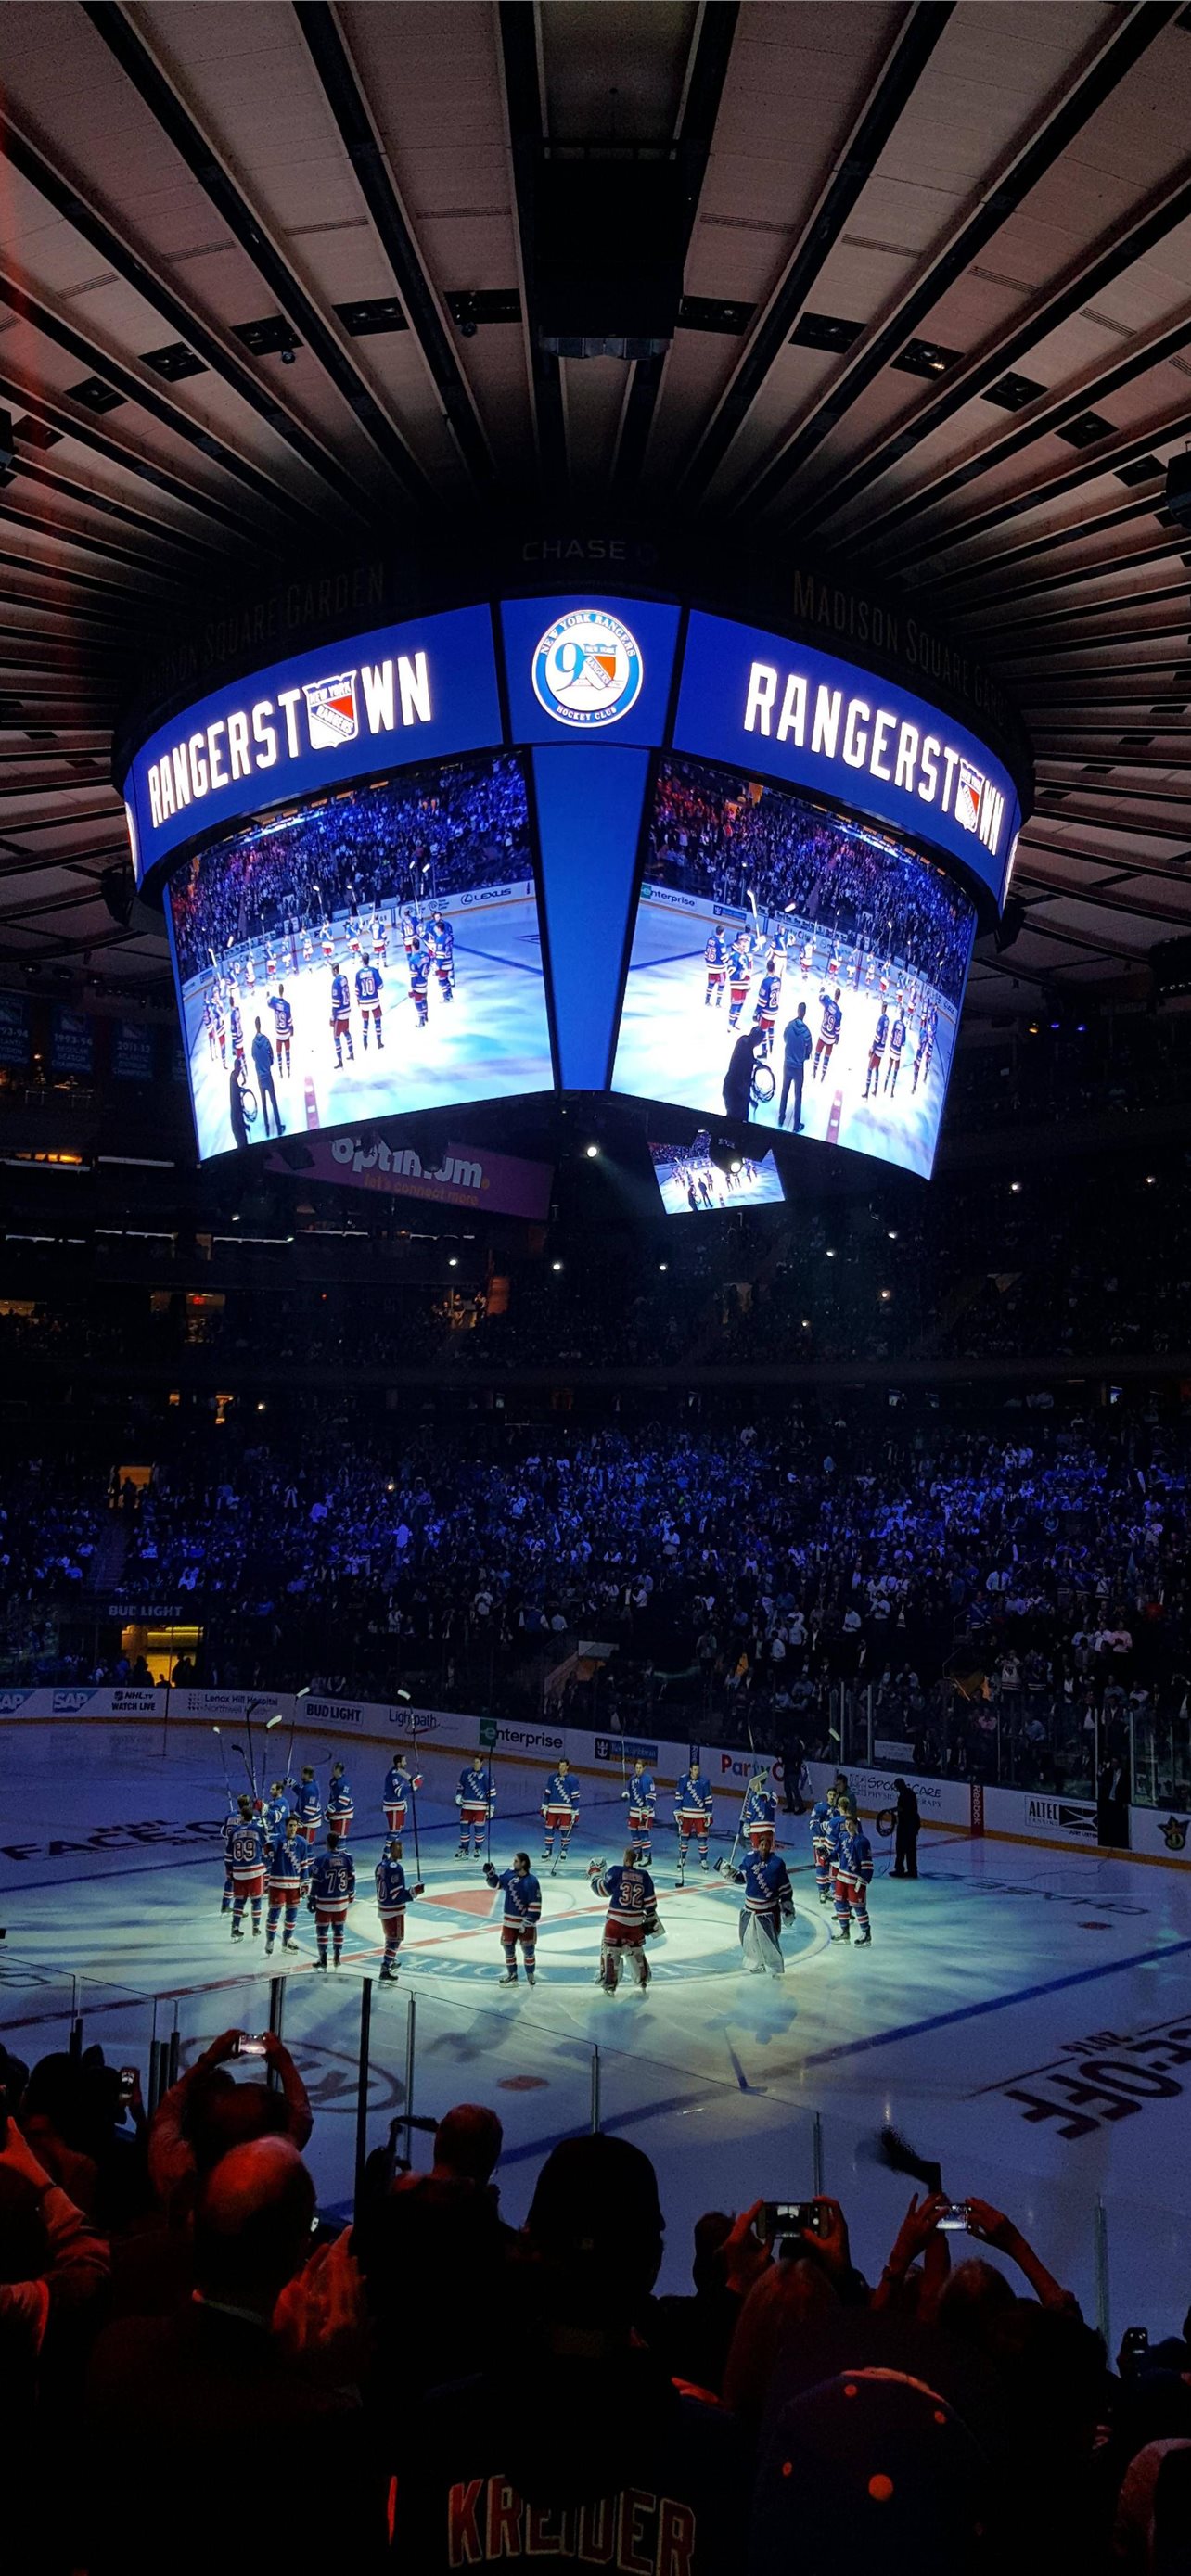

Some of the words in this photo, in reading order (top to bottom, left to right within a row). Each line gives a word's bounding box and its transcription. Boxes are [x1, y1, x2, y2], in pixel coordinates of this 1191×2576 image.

[521, 539, 627, 562] CHASE
[285, 561, 385, 629] GARDEN
[793, 568, 899, 654] MADISON
[540, 625, 561, 656] NEW
[559, 614, 592, 631] YORK
[595, 614, 636, 657] RANGERS
[557, 705, 592, 721] HOCKEY
[595, 705, 617, 721] CLUB
[474, 887, 512, 901] LEXUS
[643, 886, 696, 907] enterprise
[393, 1181, 446, 1201] connect
[109, 1605, 135, 1617] BUD
[140, 1605, 184, 1617] LIGHT
[0, 1694, 24, 1709] AP
[54, 1693, 88, 1709] SAP
[112, 1702, 137, 1711] WATCH
[139, 1702, 156, 1711] LIVE
[205, 1694, 229, 1702] Lenox
[232, 1695, 245, 1703] Hill
[306, 1703, 329, 1716] BUD
[331, 1707, 362, 1722] LIGHT
[482, 1726, 563, 1749] enterprise
[973, 1784, 981, 1826] Reebok
[1029, 1801, 1058, 1820] ALTEC
[233, 1839, 256, 1862] 89
[326, 1868, 348, 1894] 73
[619, 1881, 645, 1908] 32
